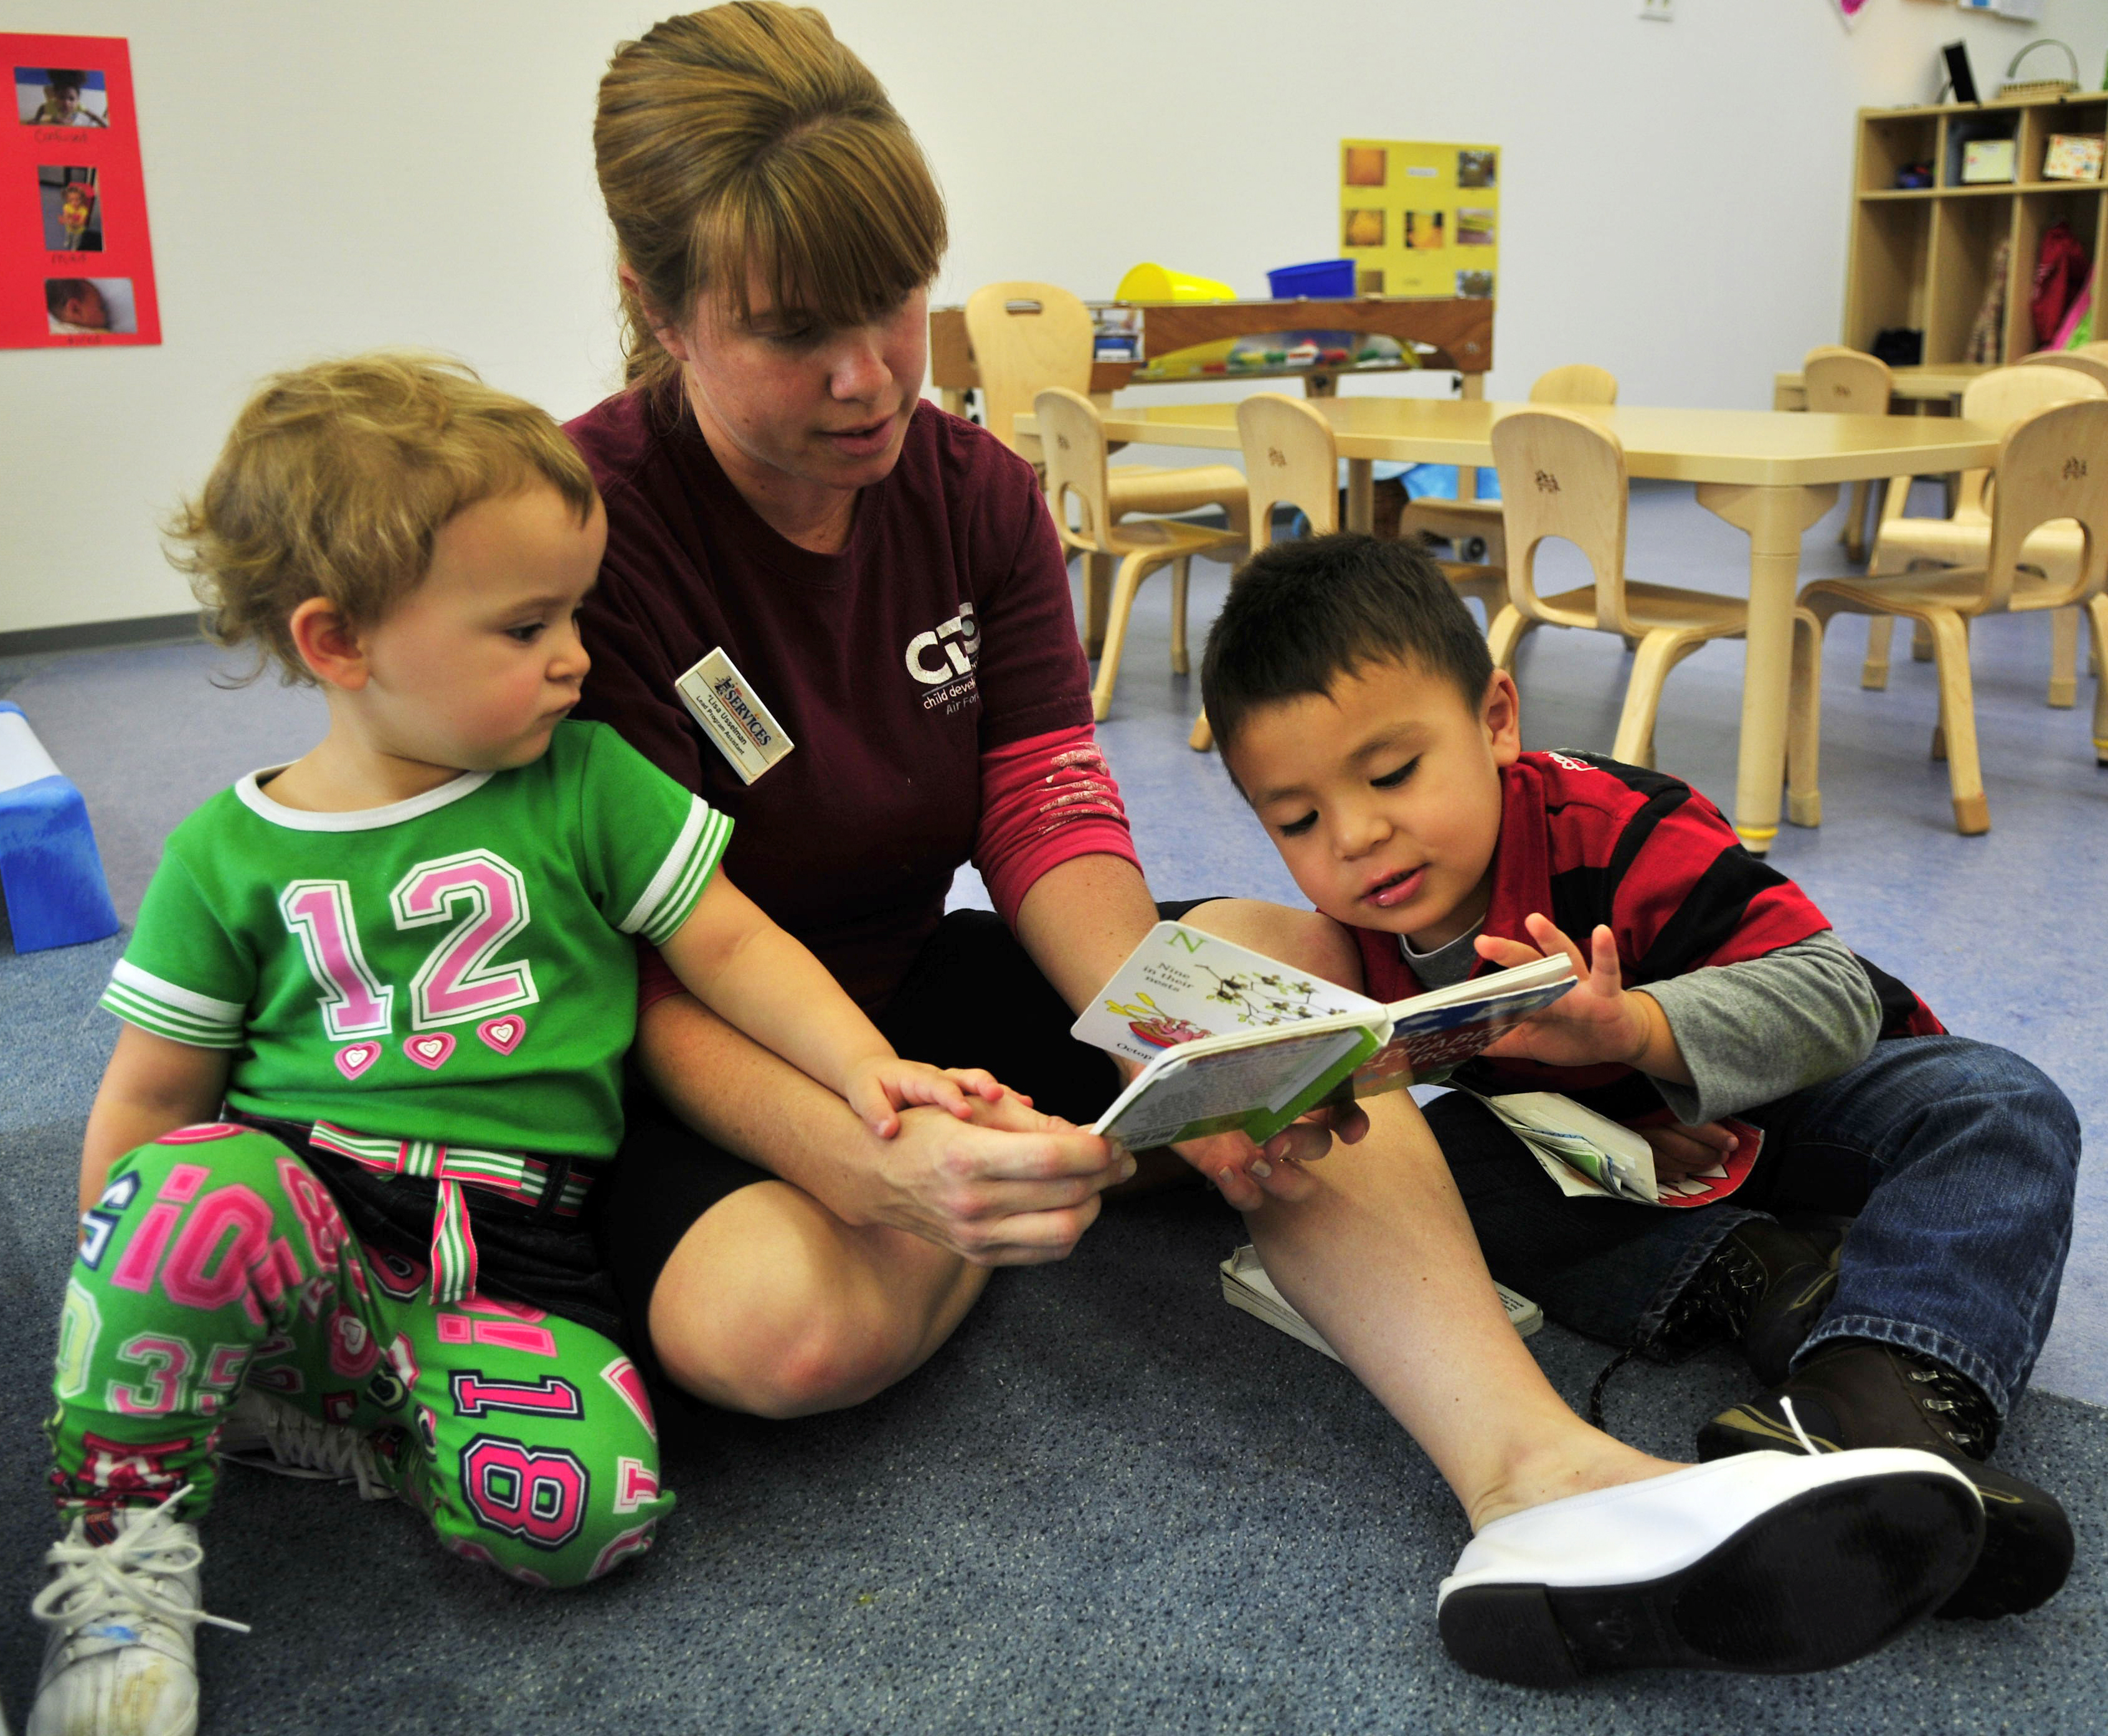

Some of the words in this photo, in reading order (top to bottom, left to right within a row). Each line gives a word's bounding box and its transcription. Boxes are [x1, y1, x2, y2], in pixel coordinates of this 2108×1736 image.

[924, 690, 948, 710] child
[949, 677, 976, 697] devel
[947, 701, 961, 715] Air
[963, 693, 979, 709] For
[696, 696, 708, 709] Lead
[707, 709, 725, 731] Program
[724, 732, 744, 755] Assistant
[721, 712, 747, 745] Usselman
[725, 689, 771, 745] SERVICES
[279, 848, 539, 1041] 12
[1165, 930, 1209, 953] N
[1158, 963, 1190, 978] Nine
[1117, 1042, 1155, 1060] Octop
